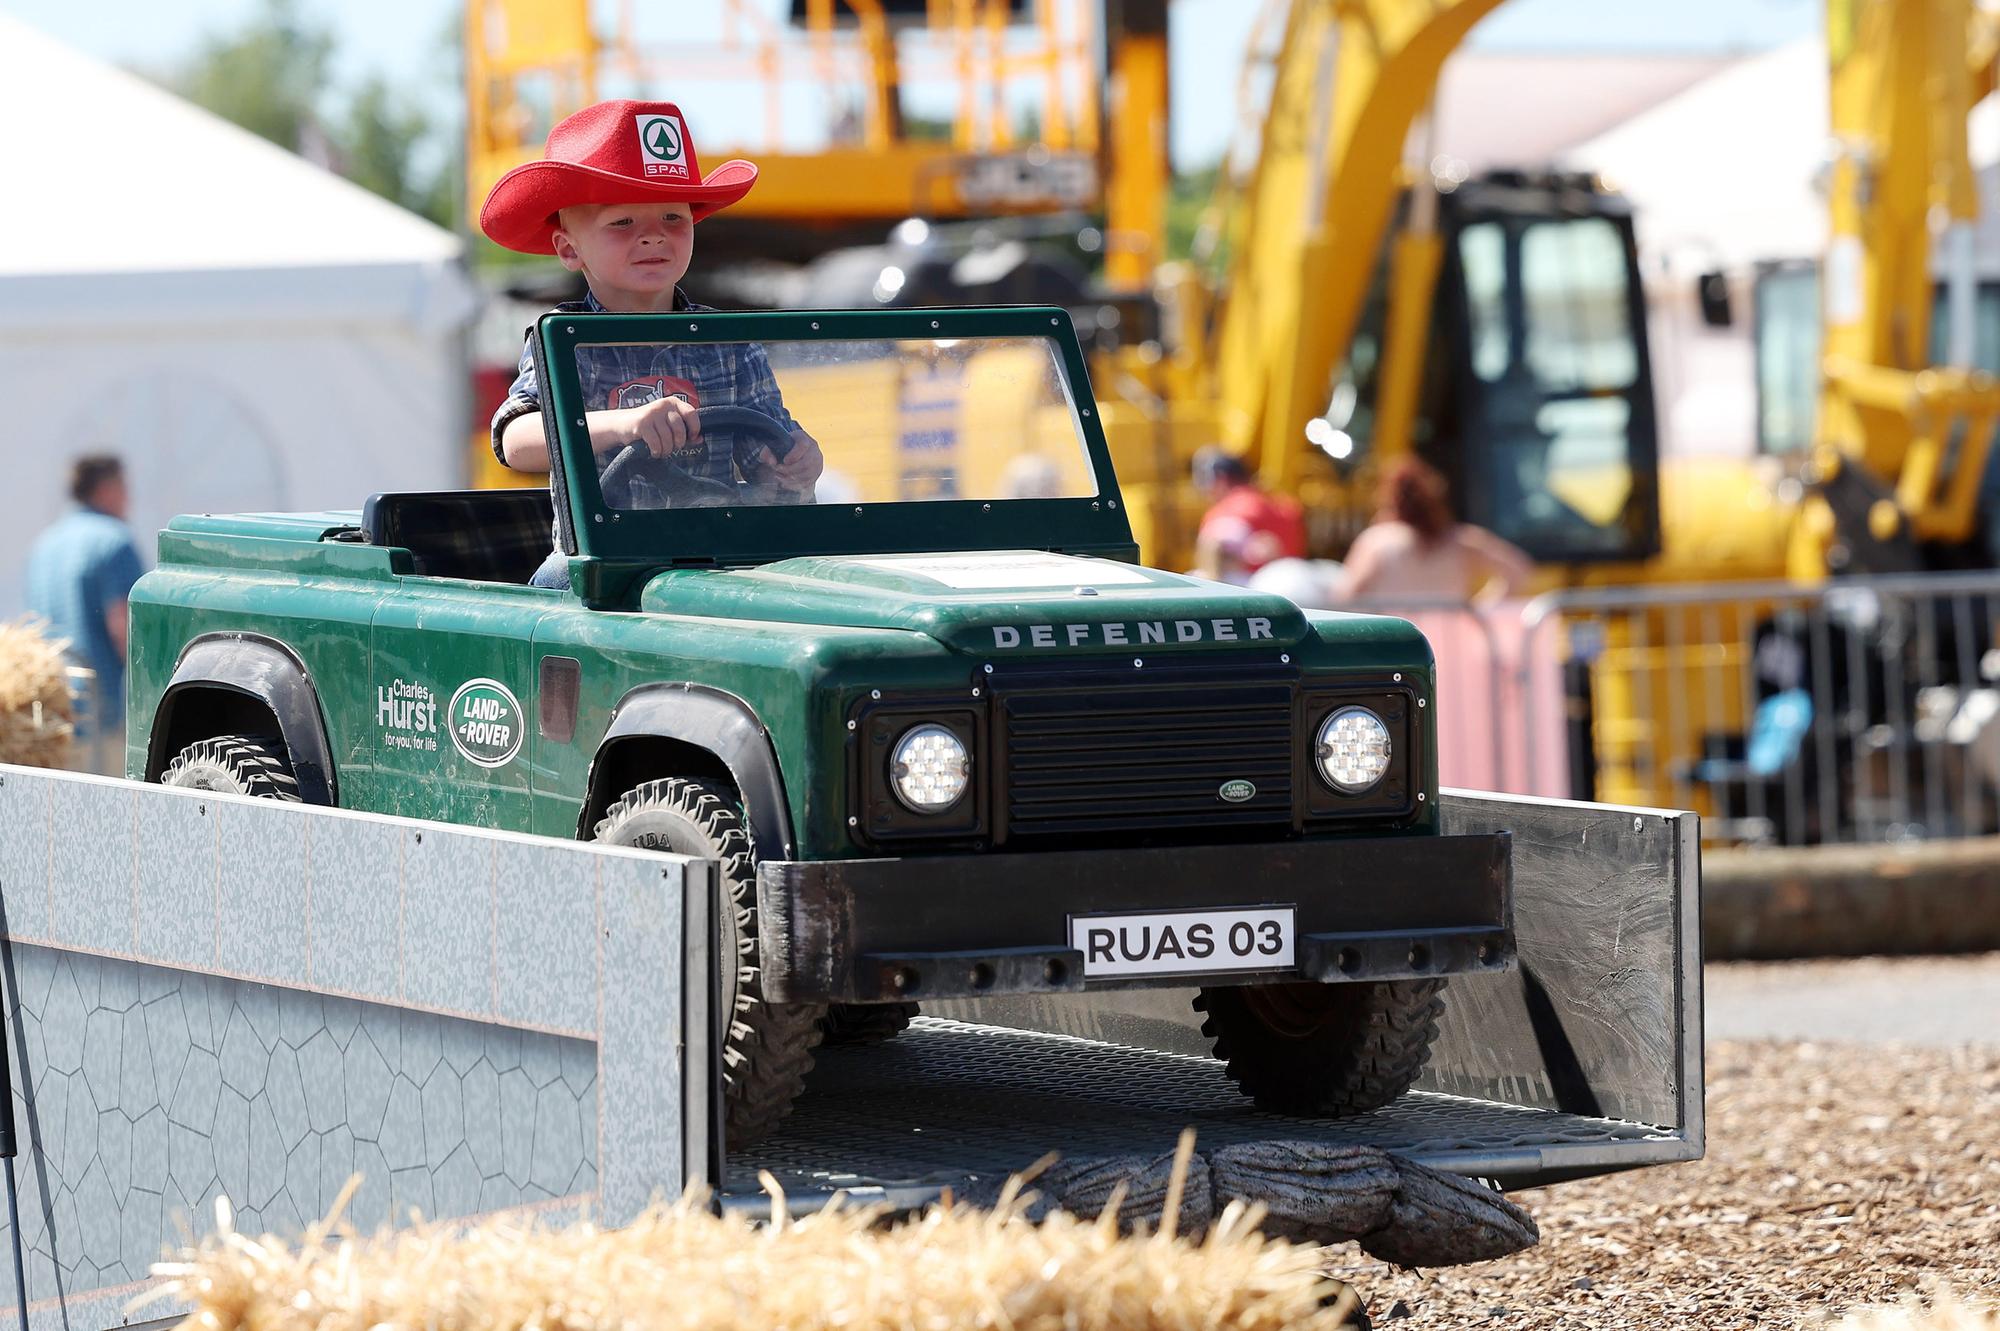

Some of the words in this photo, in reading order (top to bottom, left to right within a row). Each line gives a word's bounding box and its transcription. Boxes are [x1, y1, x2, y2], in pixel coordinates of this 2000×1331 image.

[647, 165, 687, 176] SPAR
[992, 617, 1274, 649] DEFENDER
[393, 678, 429, 700] Charles
[378, 686, 437, 733] Hurst
[385, 731, 396, 746] for
[413, 734, 424, 750] for
[425, 736, 437, 751] life
[1088, 922, 1215, 963] RUAS
[1228, 920, 1283, 957] 03
